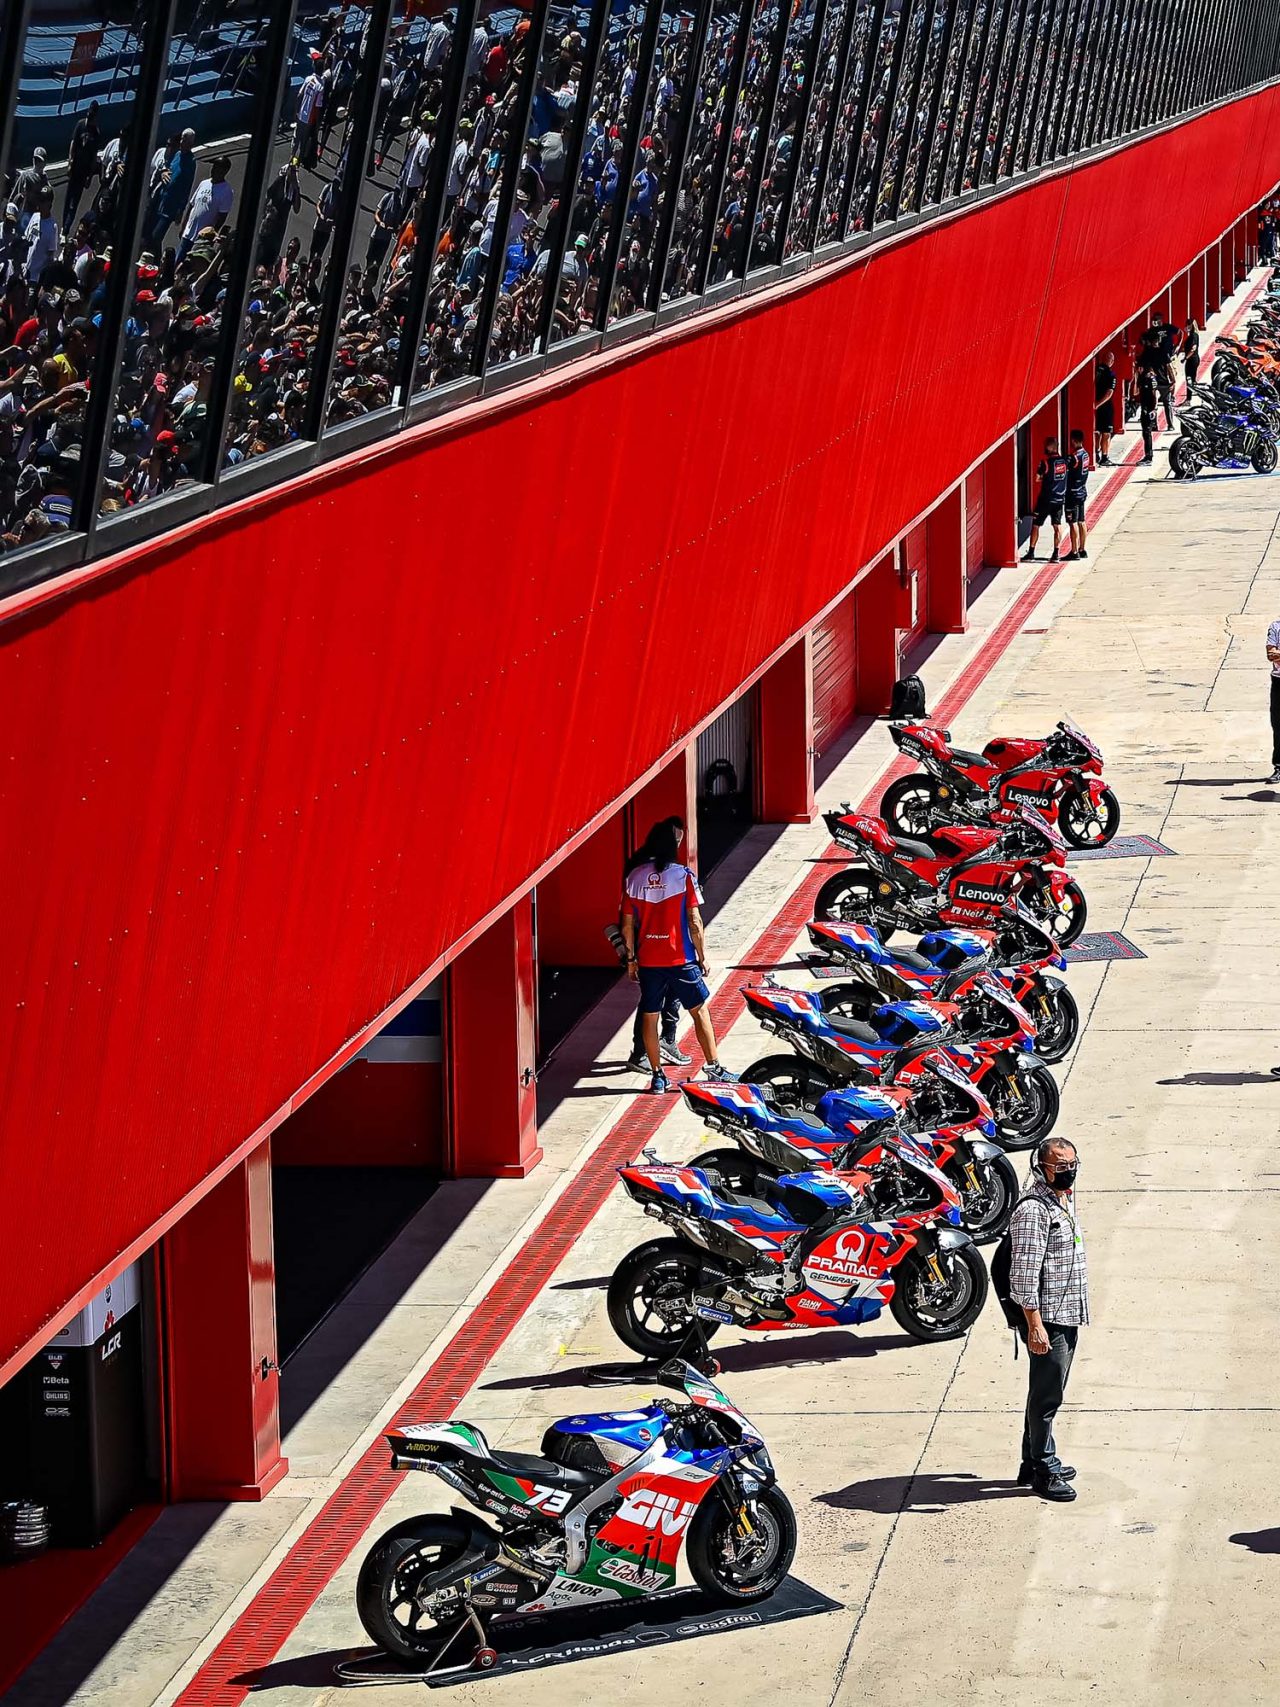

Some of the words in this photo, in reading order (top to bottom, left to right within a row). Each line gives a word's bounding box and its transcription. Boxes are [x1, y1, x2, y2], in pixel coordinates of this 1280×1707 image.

[1008, 790, 1049, 807] Lenovo
[958, 885, 1006, 903] Lenovo
[807, 1254, 879, 1278] PRAMAC
[809, 1271, 859, 1285] GENERAC
[102, 1331, 121, 1360] LCR
[50, 1376, 70, 1385] Beta
[524, 1484, 572, 1514] 73
[555, 1580, 603, 1597] LAVOR
[699, 1614, 755, 1630] Castrol
[566, 1638, 635, 1657] Honda
